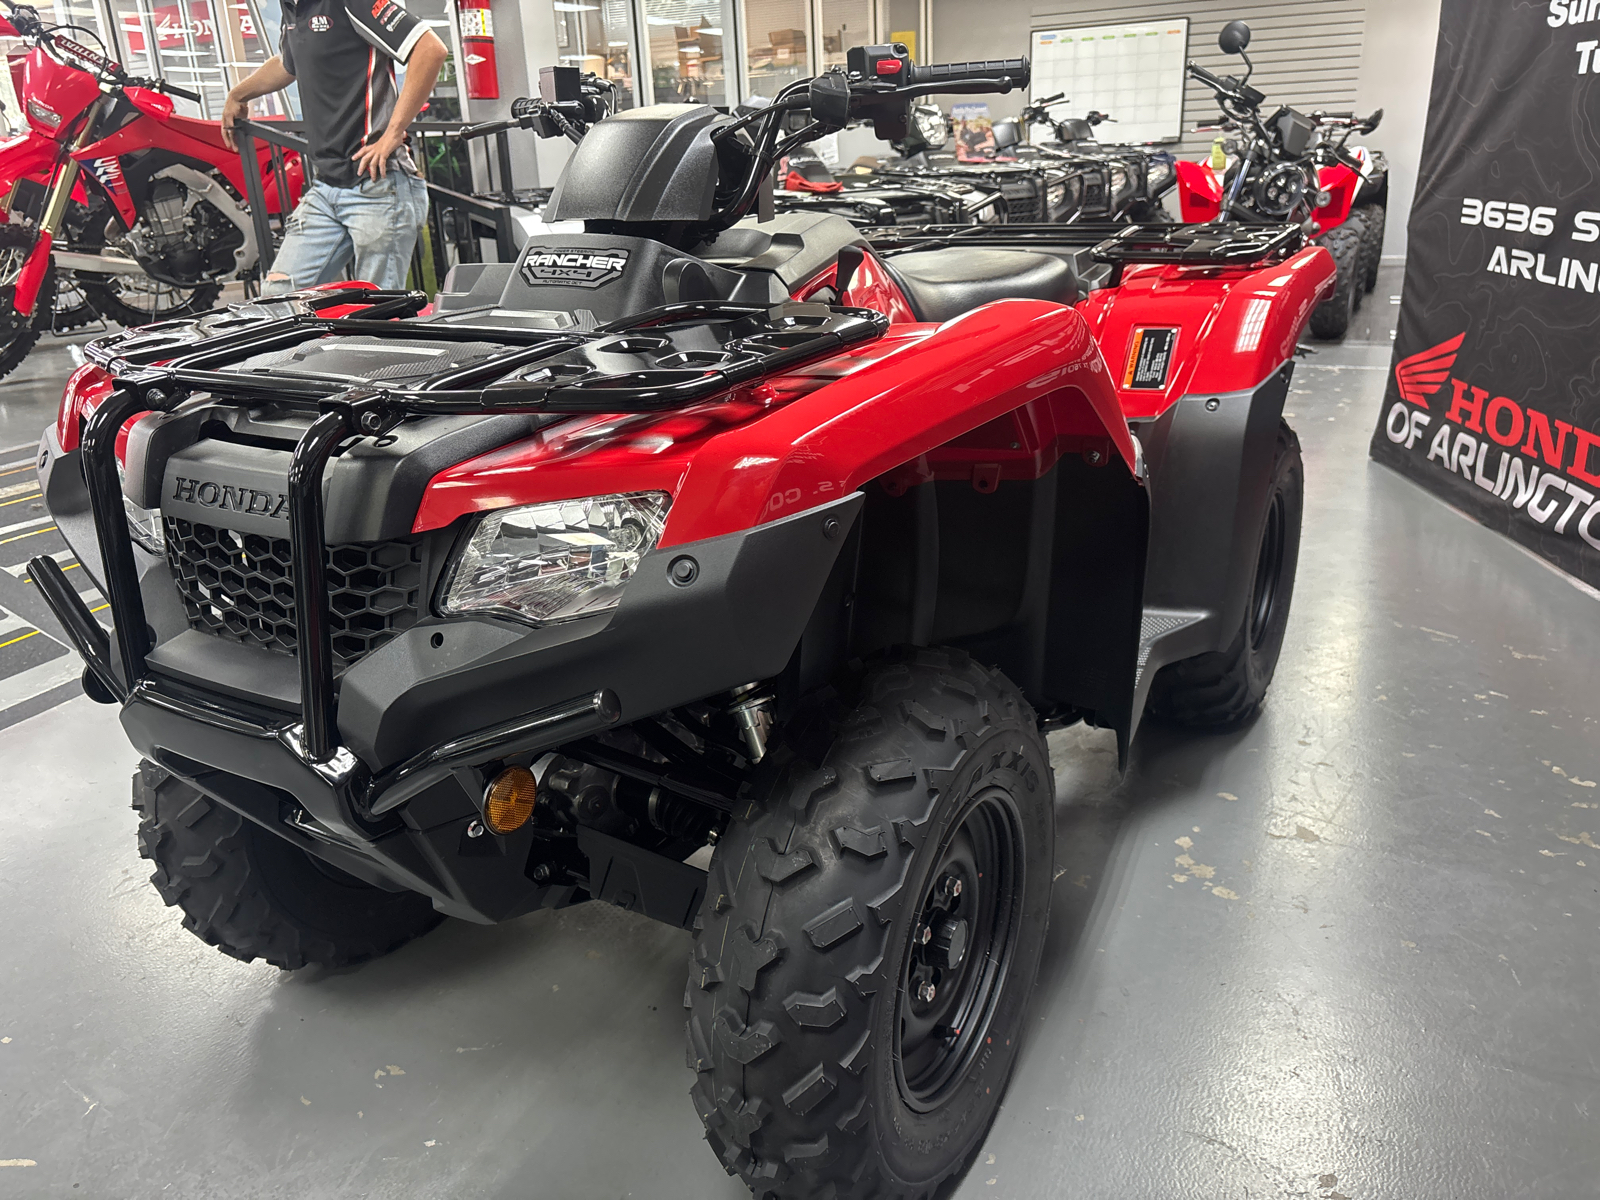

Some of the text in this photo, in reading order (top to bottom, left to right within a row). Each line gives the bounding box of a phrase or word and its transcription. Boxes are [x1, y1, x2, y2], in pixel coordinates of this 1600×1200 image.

[1460, 198, 1557, 236] 3636
[523, 254, 627, 271] RANCHER
[1486, 246, 1600, 294] ARLIN
[1386, 402, 1431, 450] OF
[173, 476, 289, 520] HONDA
